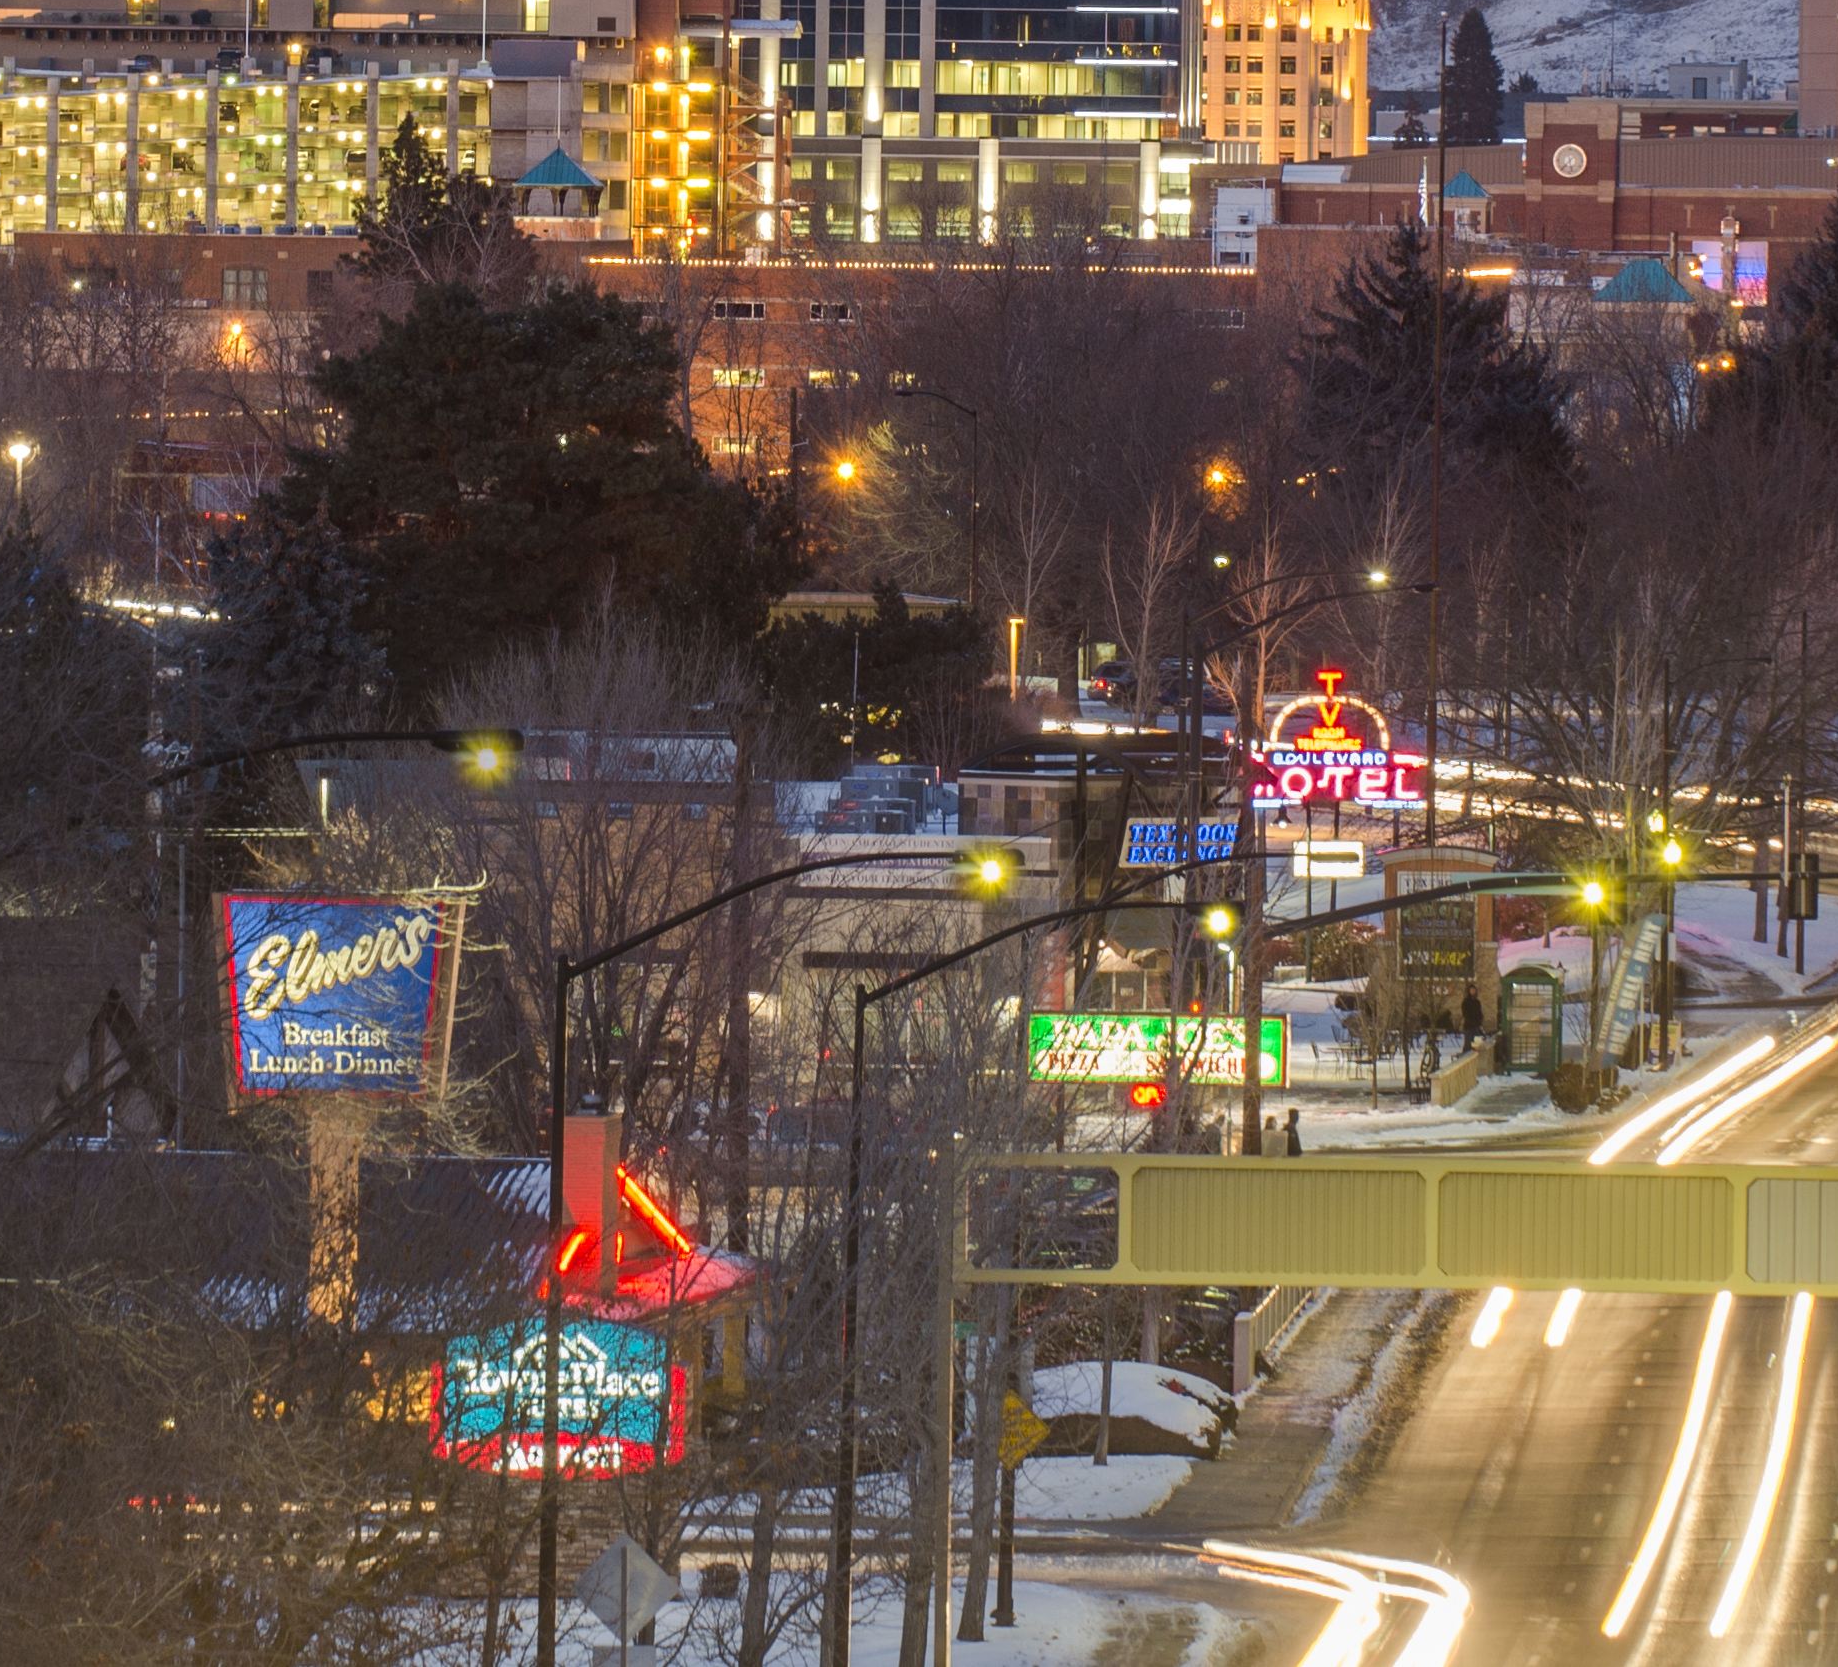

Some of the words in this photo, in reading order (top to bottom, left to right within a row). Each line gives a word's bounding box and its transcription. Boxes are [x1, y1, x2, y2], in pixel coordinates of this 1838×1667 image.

[1272, 751, 1387, 766] BOULEVARD
[1253, 766, 1420, 800] OTEL
[1131, 823, 1239, 843] TEXOOK
[243, 914, 431, 1021] Elmer's
[283, 1022, 390, 1047] Breakfast
[1053, 1020, 1148, 1050] PAPA
[1048, 1052, 1099, 1071] PIZZA
